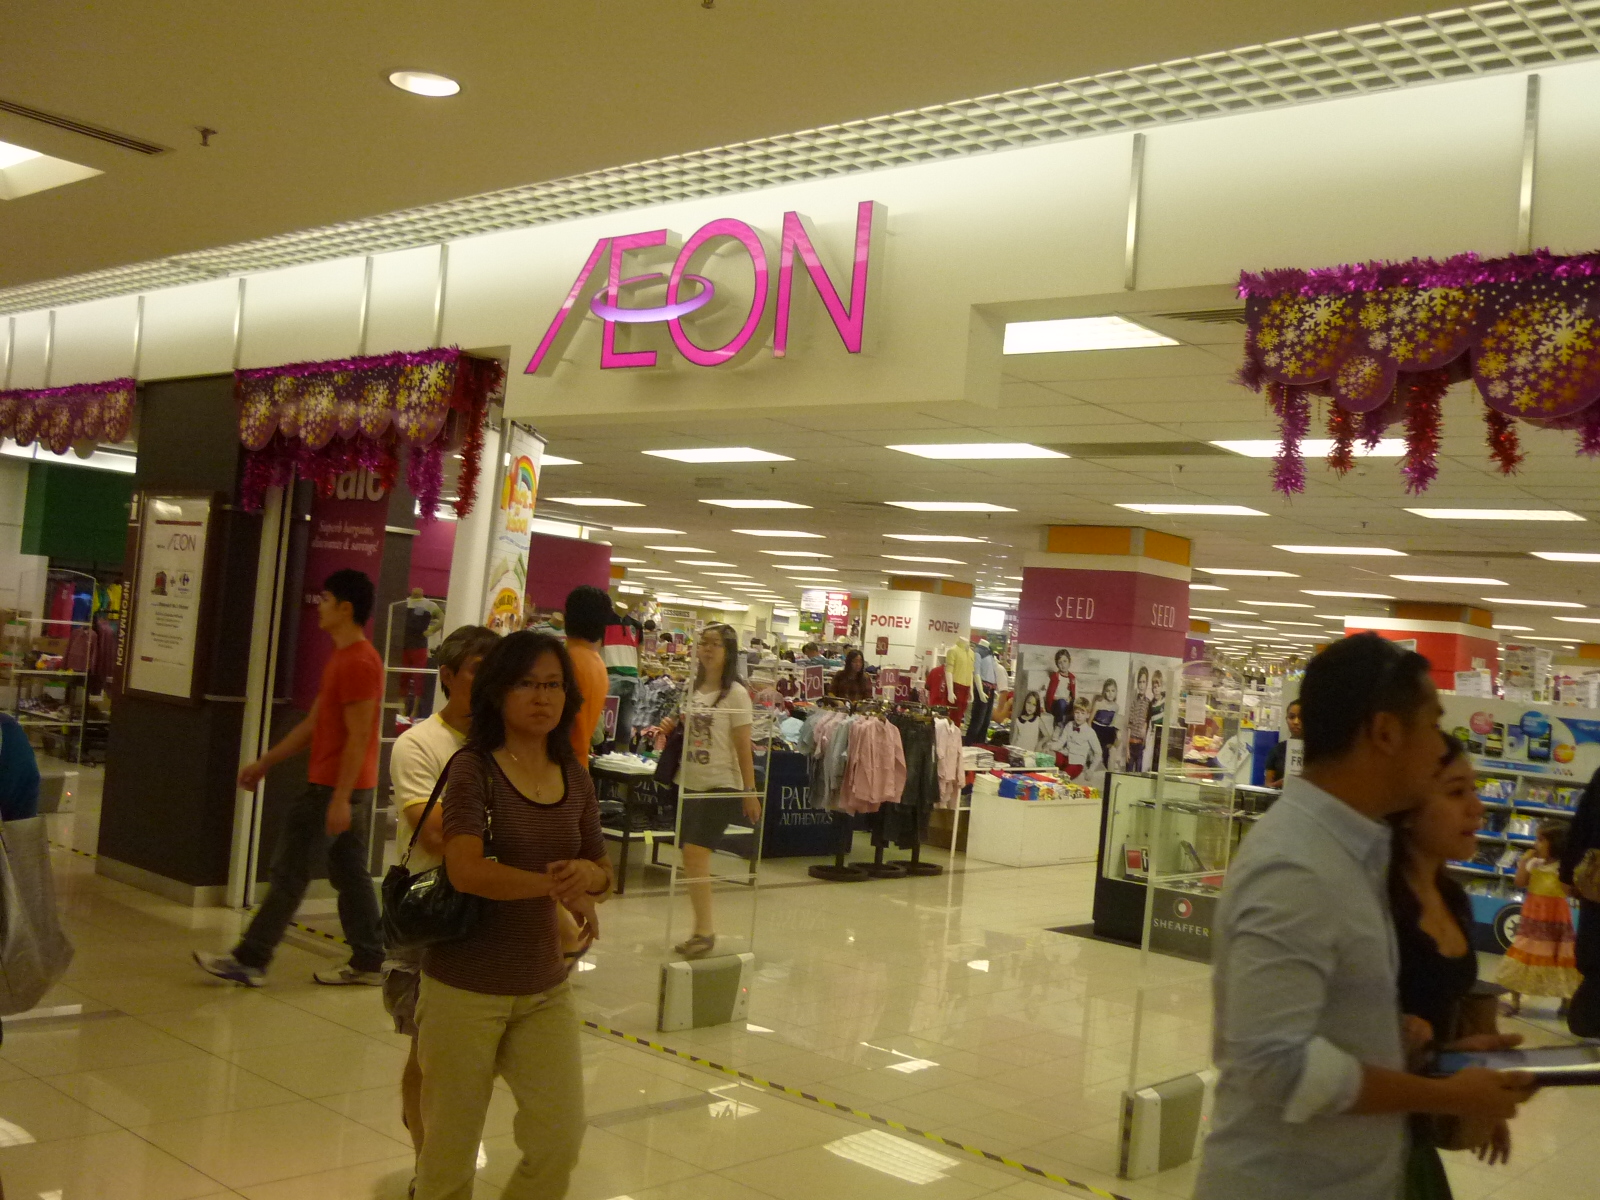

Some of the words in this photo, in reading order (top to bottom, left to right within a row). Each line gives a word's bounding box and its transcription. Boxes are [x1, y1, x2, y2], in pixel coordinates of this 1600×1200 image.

[827, 600, 849, 617] sale
[1054, 595, 1095, 620] SEED
[1151, 603, 1176, 628] SEED
[116, 581, 131, 666] INFORMATION
[870, 614, 912, 629] PONEY
[928, 619, 960, 634] PONEY
[779, 812, 834, 826] AUTHENTICS
[1153, 918, 1210, 937] SHEAFFER
